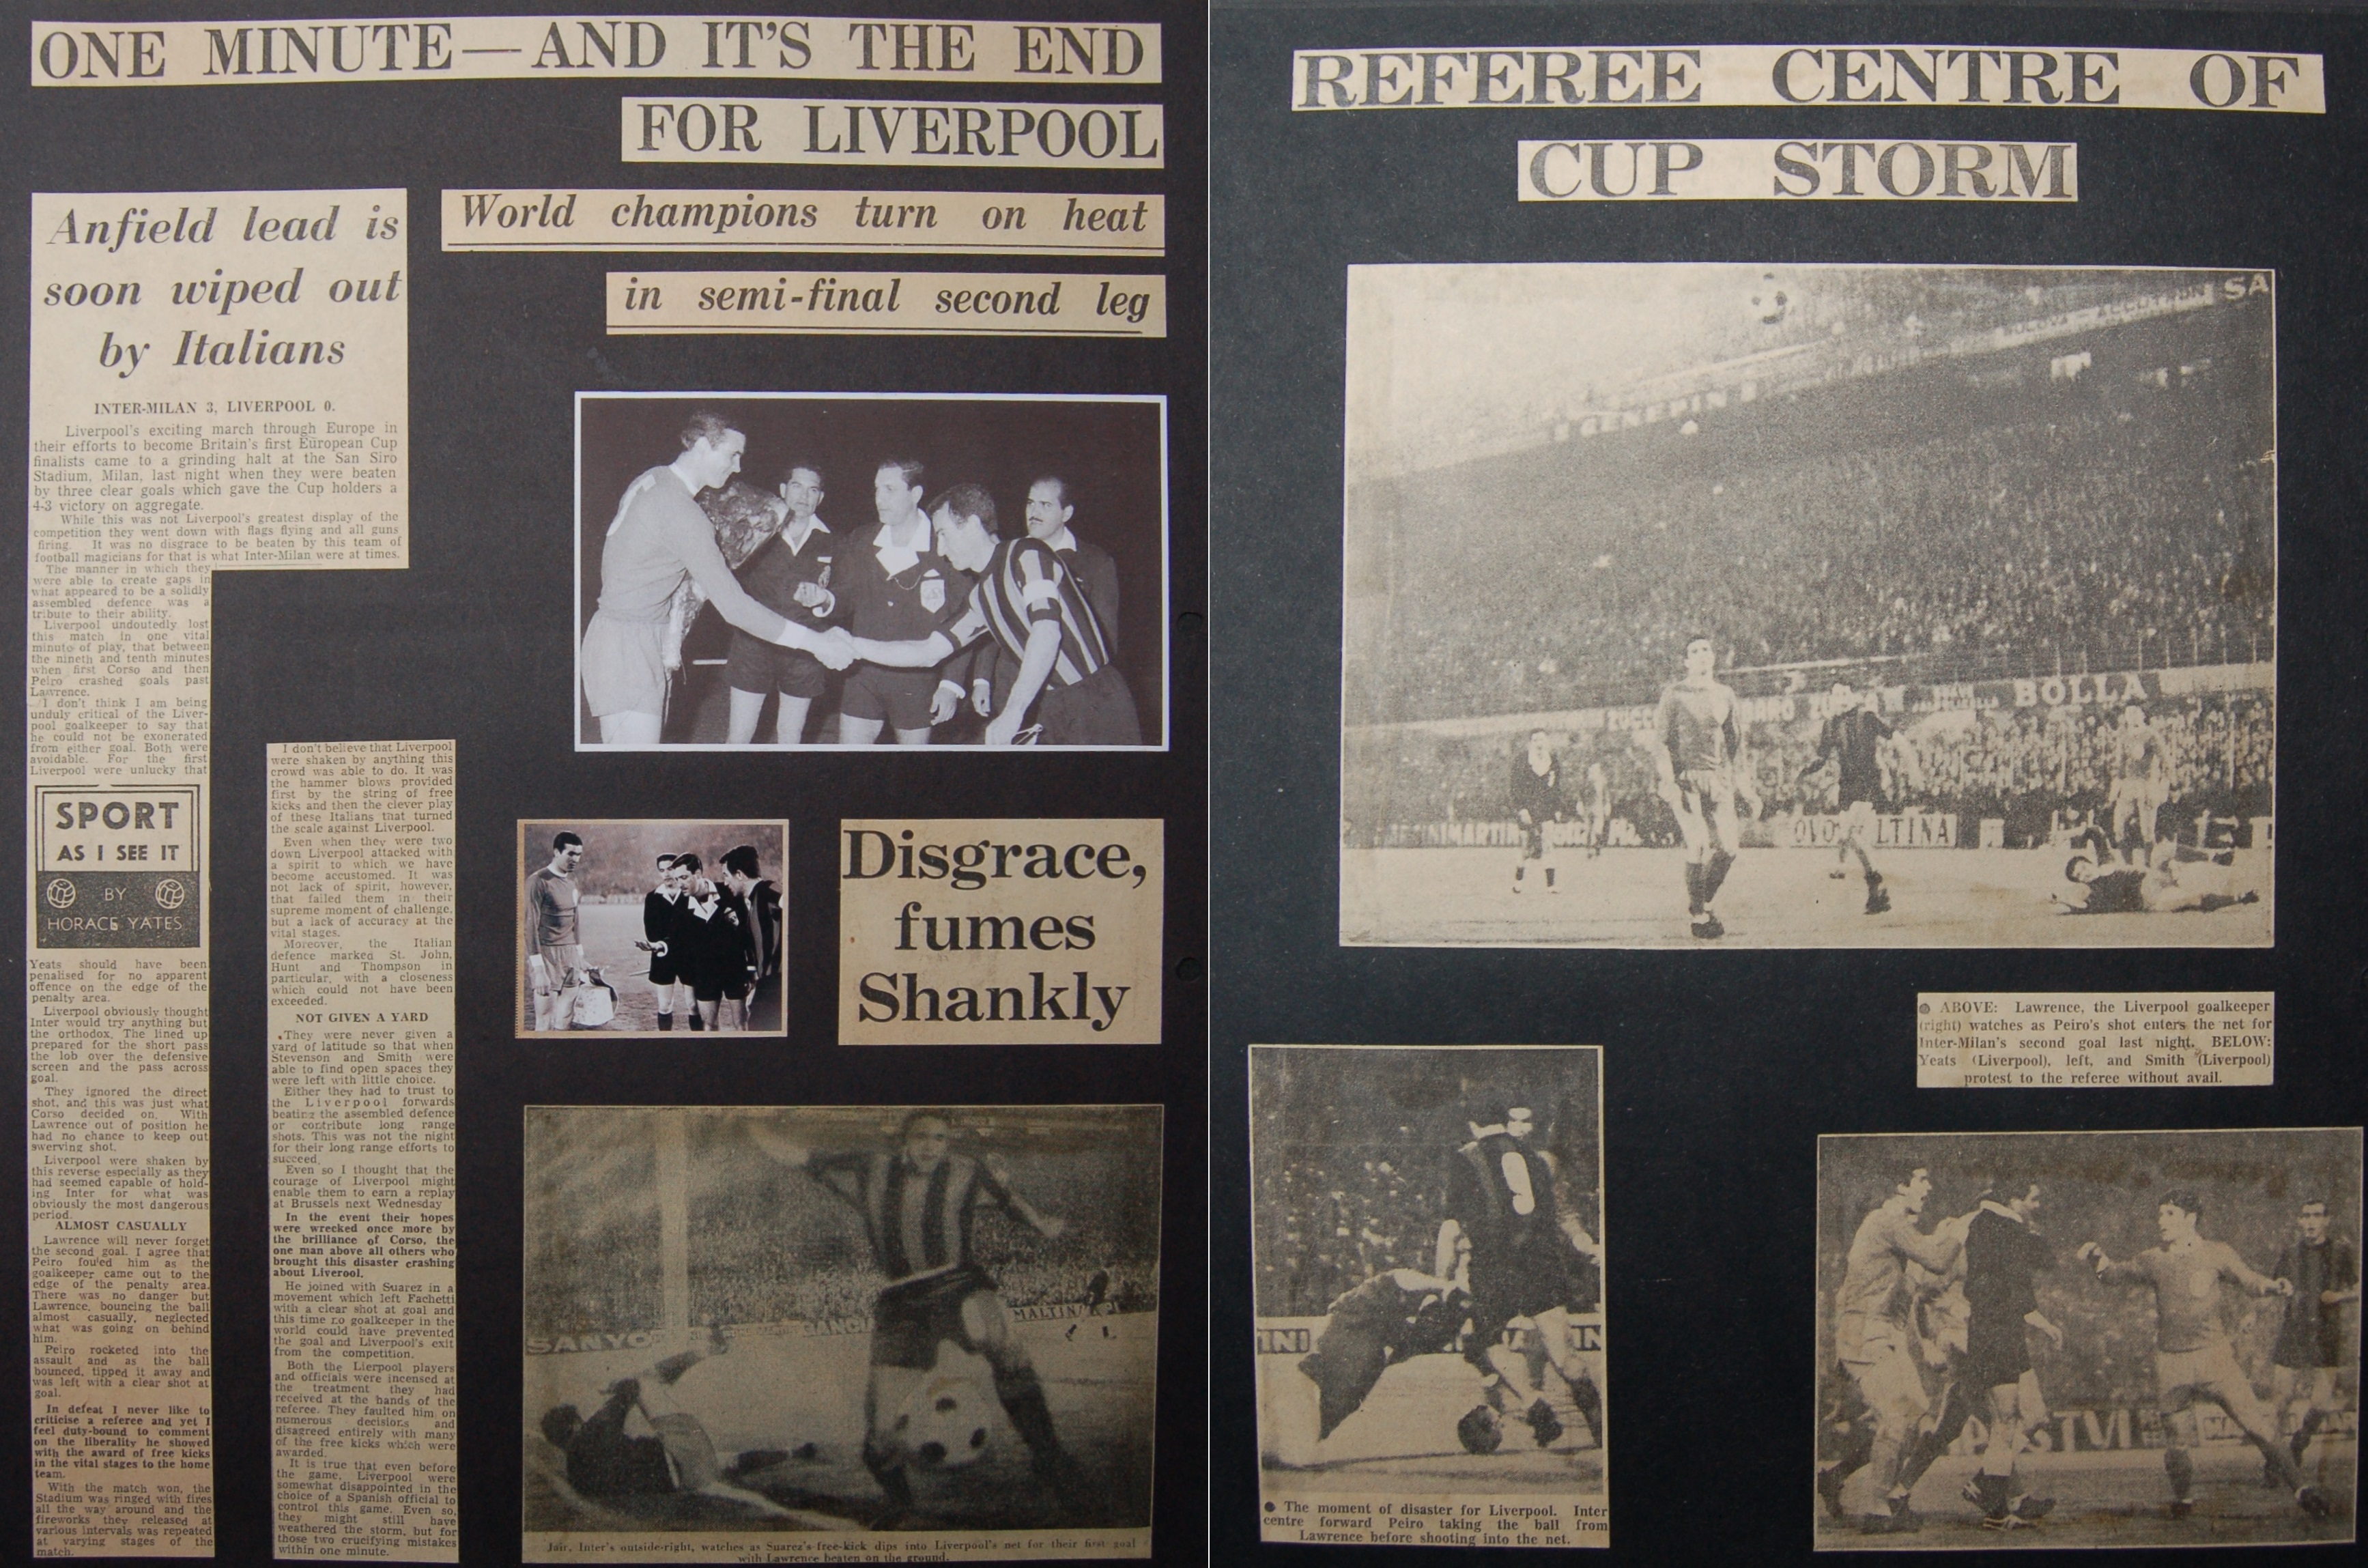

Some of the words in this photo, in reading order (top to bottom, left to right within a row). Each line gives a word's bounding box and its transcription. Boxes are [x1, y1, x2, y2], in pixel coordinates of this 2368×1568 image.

[39, 29, 166, 79] ONE
[702, 21, 812, 70] IT'S
[850, 23, 975, 72] THE
[1014, 25, 1143, 76] END
[1298, 49, 1701, 107] REFEREE
[1771, 49, 2120, 105] CENTRE
[2188, 53, 2300, 108] OF
[638, 104, 761, 152] FOR
[804, 102, 1160, 158] LIVERPOOL
[1529, 143, 1704, 199] CUP
[1775, 143, 2072, 198] STORM
[463, 194, 576, 228] World
[612, 193, 817, 234] champions
[856, 197, 937, 229] turn
[983, 207, 1026, 229] on
[1064, 198, 1147, 232] heat
[48, 208, 218, 253] Anfield
[244, 205, 340, 242] lead
[367, 205, 398, 240] is
[44, 282, 140, 307] soon
[173, 268, 304, 315] wiped
[330, 270, 401, 302] out
[626, 277, 661, 310] in
[699, 277, 900, 312] semi-final
[936, 281, 1061, 315] second
[1096, 281, 1150, 323] leg
[100, 332, 149, 378] by
[173, 329, 344, 365] Italians
[228, 400, 315, 412] LIVERPOOL
[66, 424, 139, 438] Liverpool's
[149, 423, 203, 439] exciting
[212, 423, 253, 436] march
[263, 422, 315, 439] through
[326, 422, 375, 438] Europe
[385, 421, 397, 433] in
[35, 440, 66, 452] their
[73, 440, 116, 452] efforts
[124, 440, 136, 451] to
[144, 440, 192, 451] become
[201, 438, 257, 450] Britain's
[265, 438, 291, 450] first
[299, 438, 363, 451] European
[371, 438, 397, 452] Cup
[44, 620, 100, 631] Liverpool
[112, 619, 177, 630] undoutedly
[189, 619, 208, 629] lost
[2014, 673, 2148, 707] BOLLA
[284, 745, 287, 753] I
[292, 744, 321, 754] don't
[325, 743, 367, 753] believe
[369, 743, 392, 752] that
[397, 741, 452, 753] Liverpool
[56, 802, 179, 829] SPORT
[1795, 816, 1949, 844] OVOLTINA
[57, 845, 85, 861] AS
[98, 845, 103, 861] I
[117, 845, 147, 861] SEE
[161, 845, 179, 860] IT
[842, 829, 1146, 890] Disgrace,
[104, 887, 127, 901] BY
[48, 917, 119, 931] HORACE
[128, 917, 182, 930] YATES
[895, 902, 1095, 951] fumes
[859, 972, 1130, 1031] Shankly
[2094, 1001, 2114, 1013] the
[2125, 1000, 2188, 1014] Liverpool
[2197, 1000, 2270, 1014] goalkeeper
[296, 1013, 322, 1023] NOT
[329, 1013, 369, 1023] GIVEN
[377, 1013, 385, 1022] A
[391, 1012, 428, 1022] YARD
[1920, 1019, 1961, 1033] (right)
[1969, 1018, 2023, 1031] watches
[2031, 1022, 2044, 1031] as
[2054, 1018, 2099, 1031] Peiro's
[2108, 1018, 2135, 1031] shot
[2144, 1019, 2187, 1031] enters
[2194, 1018, 2214, 1030] the
[2223, 1019, 2244, 1030] net
[2253, 1018, 2272, 1029] for
[2020, 1036, 2064, 1049] second
[2079, 1036, 2105, 1050] goal
[2120, 1036, 2143, 1048] last
[1919, 1054, 1956, 1066] Yeats
[2107, 1055, 2131, 1066] and
[2145, 1054, 2184, 1066] Smith
[2197, 1053, 2270, 1068] (Liverpool)
[1965, 1073, 2012, 1085] protest
[2021, 1073, 2033, 1083] to
[2042, 1072, 2062, 1083] the
[2071, 1072, 2119, 1083] referee
[2128, 1071, 2178, 1083] without
[55, 1221, 109, 1230] ALMOST
[117, 1221, 186, 1231] CASUALLY
[274, 1268, 304, 1277] about
[312, 1268, 363, 1278] Liverool.
[526, 1332, 652, 1354] SANYO
[47, 1404, 58, 1414] In
[68, 1403, 102, 1414] defeat
[113, 1405, 117, 1414] I
[169, 1406, 189, 1415] like
[199, 1406, 210, 1415] to
[1284, 1501, 1309, 1513] The
[1318, 1503, 1371, 1514] moment
[1379, 1503, 1392, 1514] of
[1401, 1503, 1453, 1516] disaster
[1461, 1505, 1481, 1516] for
[1574, 1505, 1608, 1517] Inter
[1264, 1515, 1303, 1526] centre
[1320, 1516, 1371, 1528] forward
[1389, 1517, 1423, 1529] Peiro
[1440, 1518, 1481, 1533] taking
[1498, 1519, 1518, 1530] the
[1535, 1518, 1560, 1530] ball
[1576, 1519, 1608, 1531] from
[1300, 1531, 1363, 1542] Lawrence
[1371, 1531, 1412, 1543] before
[1421, 1532, 1476, 1545] shooting
[1484, 1533, 1509, 1544] into
[1517, 1533, 1537, 1545] the
[279, 1545, 314, 1554] within
[320, 1548, 341, 1556] one
